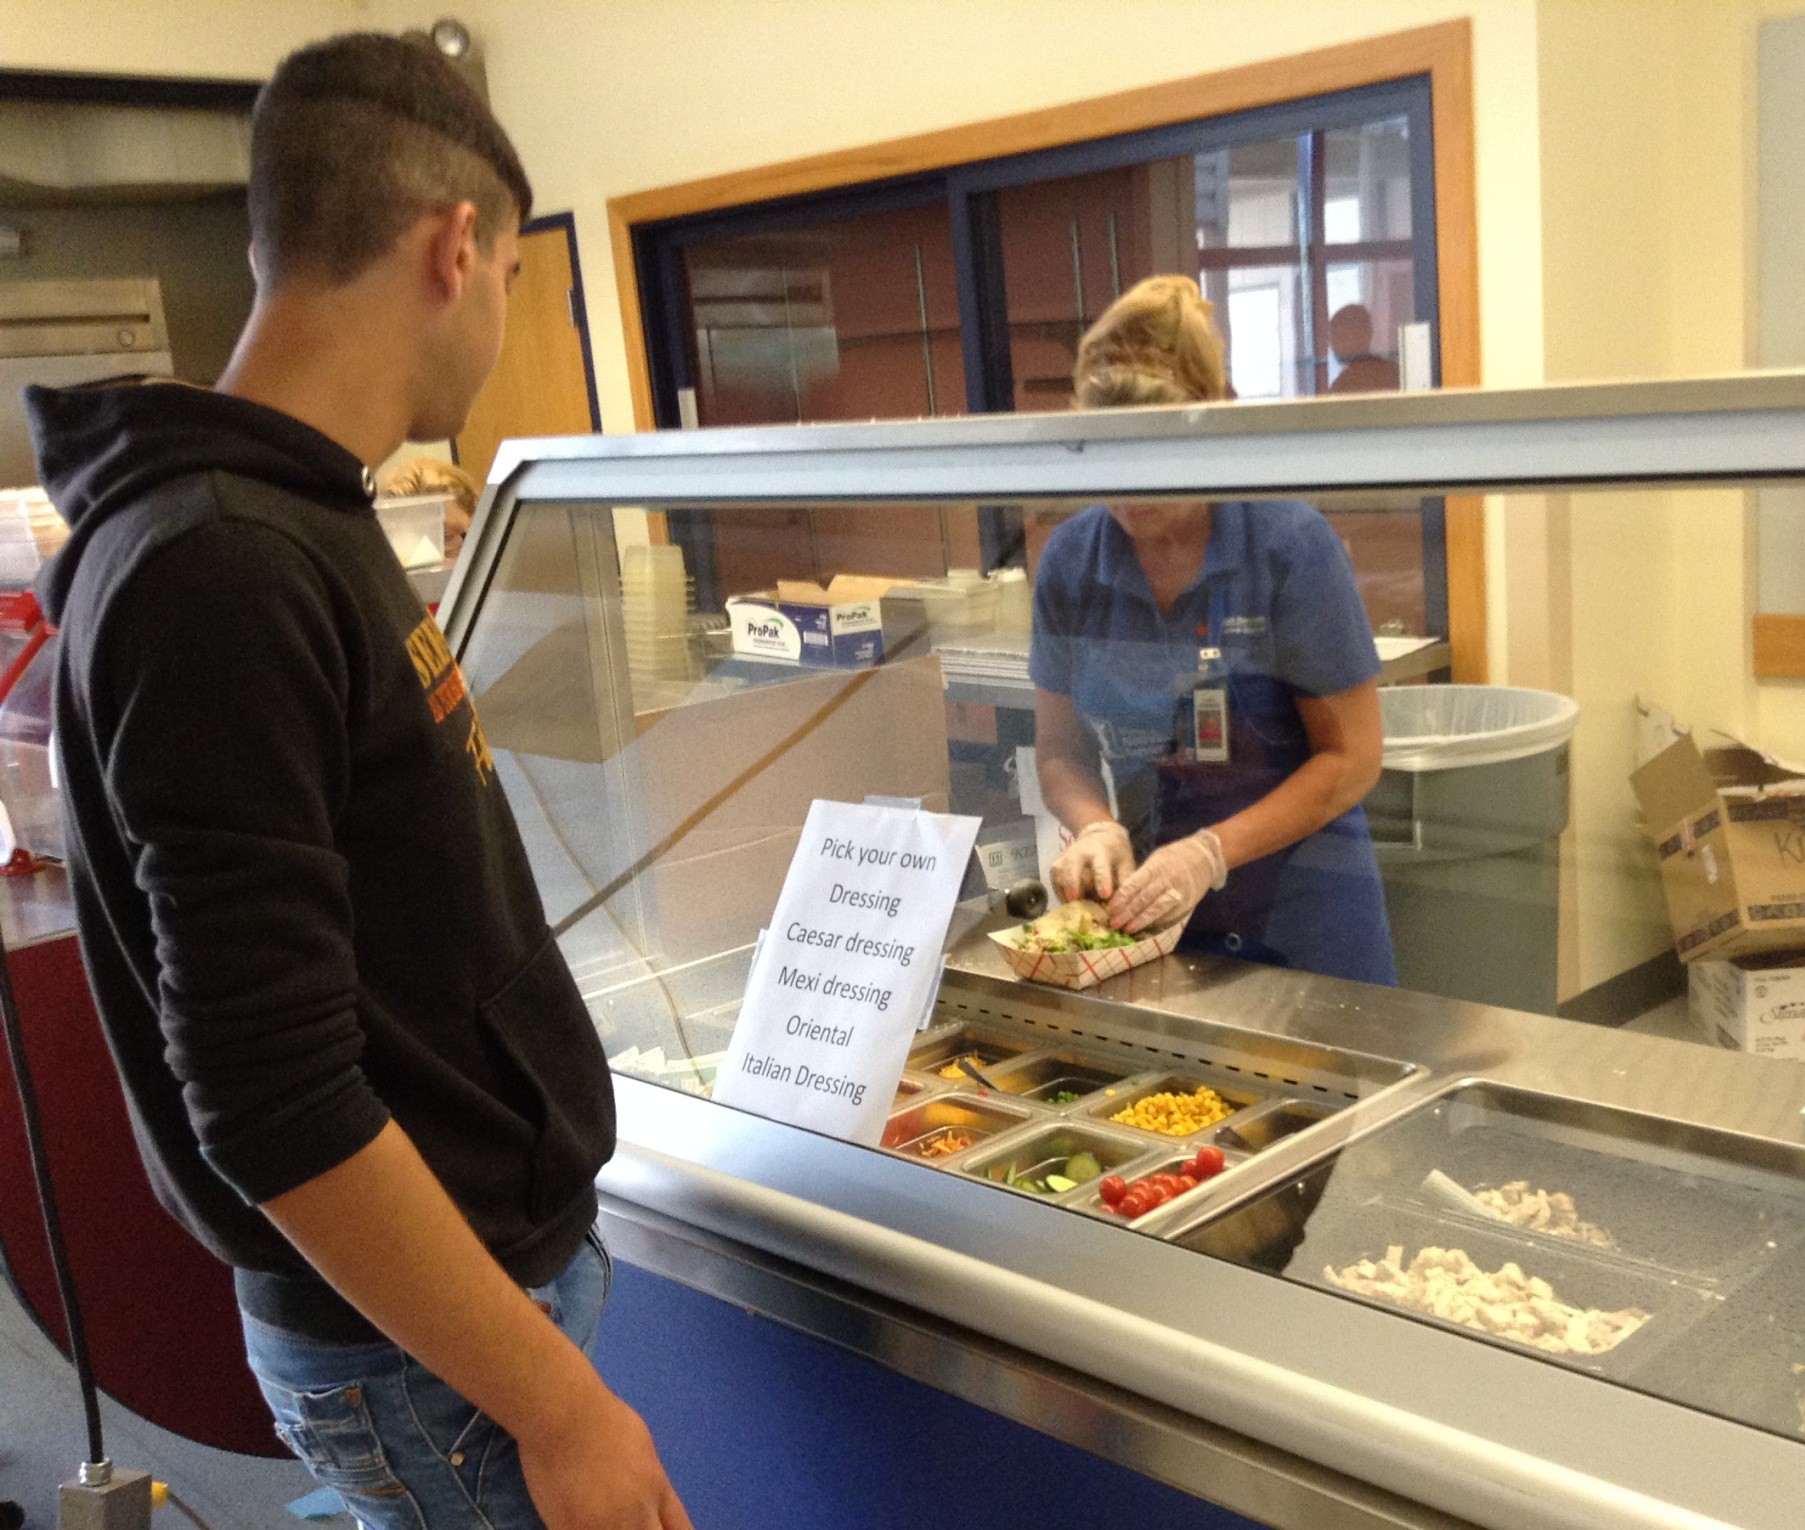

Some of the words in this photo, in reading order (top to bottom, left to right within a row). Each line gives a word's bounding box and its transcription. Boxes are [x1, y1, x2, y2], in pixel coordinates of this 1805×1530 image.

[747, 622, 779, 638] ProPak
[836, 611, 867, 621] ProPak
[820, 837, 856, 861] Pick
[857, 846, 898, 867] your
[899, 852, 937, 871] own
[828, 883, 903, 919] Dressing
[786, 921, 844, 950] Caesar
[844, 931, 916, 968] dressing
[777, 965, 820, 992] Mexi
[822, 974, 893, 1012] dressing
[785, 1014, 855, 1048] Oriental
[741, 1052, 792, 1083] Italian
[794, 1064, 868, 1106] Dressing
